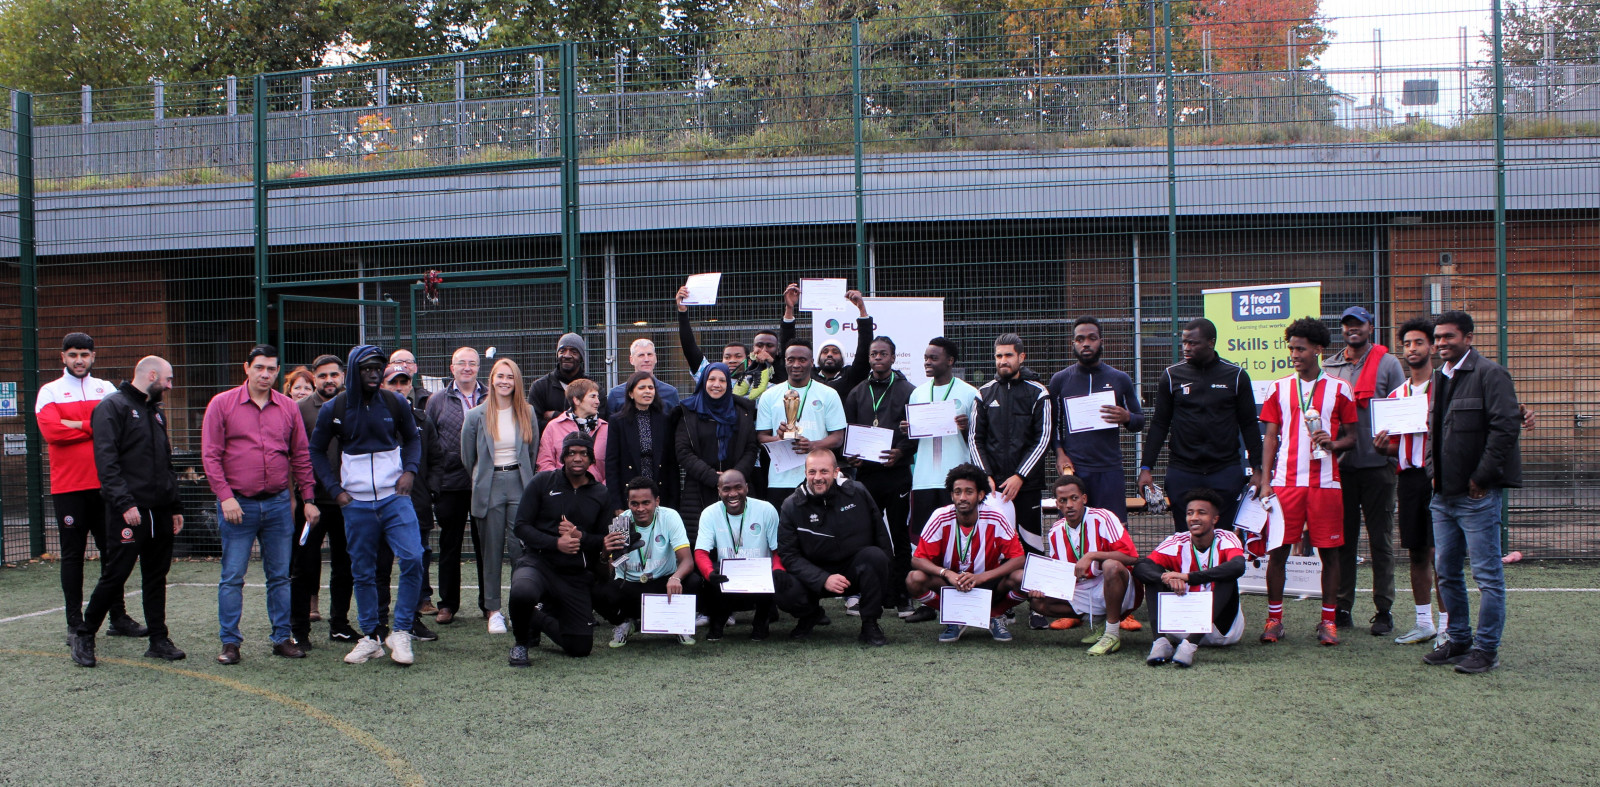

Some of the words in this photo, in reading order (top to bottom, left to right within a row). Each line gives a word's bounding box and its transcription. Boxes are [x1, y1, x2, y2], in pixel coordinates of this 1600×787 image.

[1250, 293, 1281, 304] free2
[1251, 305, 1281, 315] learn
[1228, 338, 1268, 351] Skills
[1253, 360, 1266, 370] to
